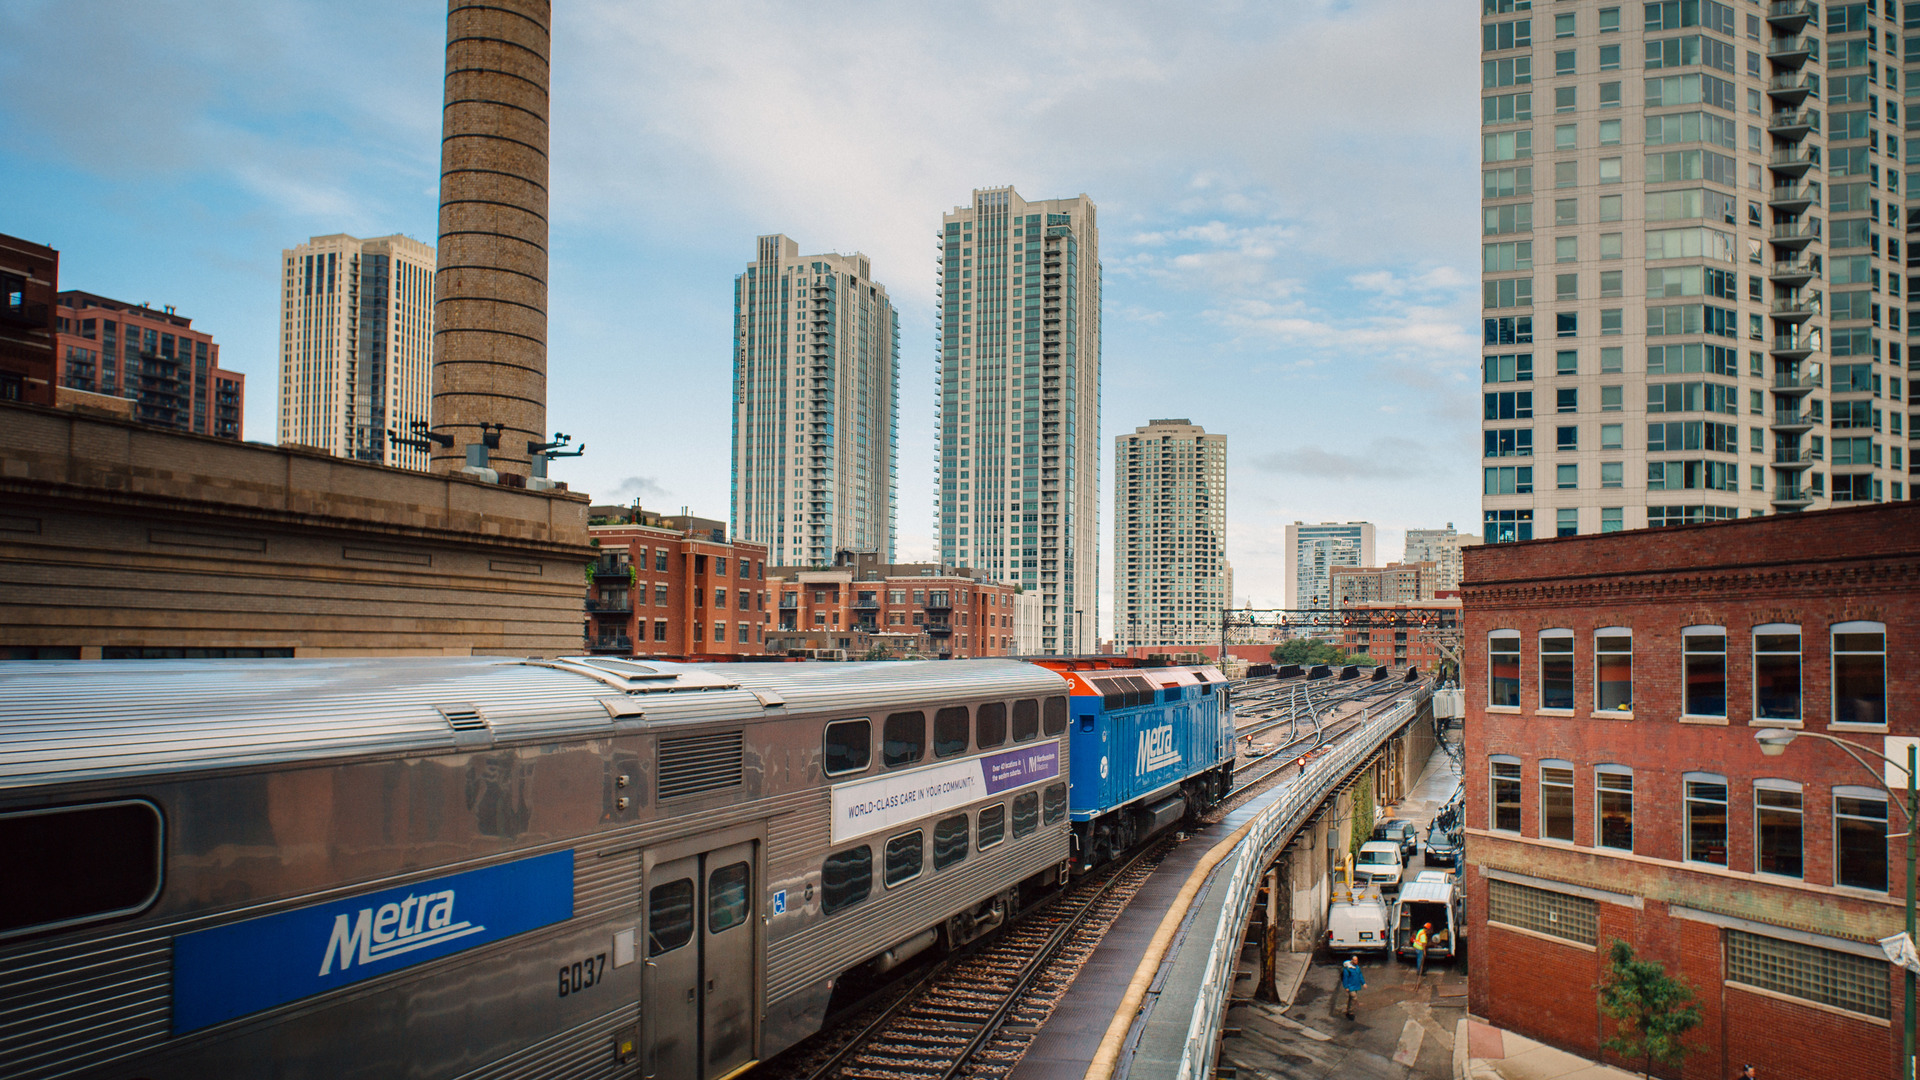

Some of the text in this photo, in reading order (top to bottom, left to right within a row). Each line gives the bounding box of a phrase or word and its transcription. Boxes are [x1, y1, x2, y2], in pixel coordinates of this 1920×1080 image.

[1135, 722, 1174, 776] Metra
[848, 795, 899, 819] WORLD-CLASS
[899, 790, 916, 805] CARE
[917, 787, 925, 801] IN
[926, 783, 942, 797] YOUR
[318, 889, 458, 977] Metra
[558, 953, 607, 997] 6037
